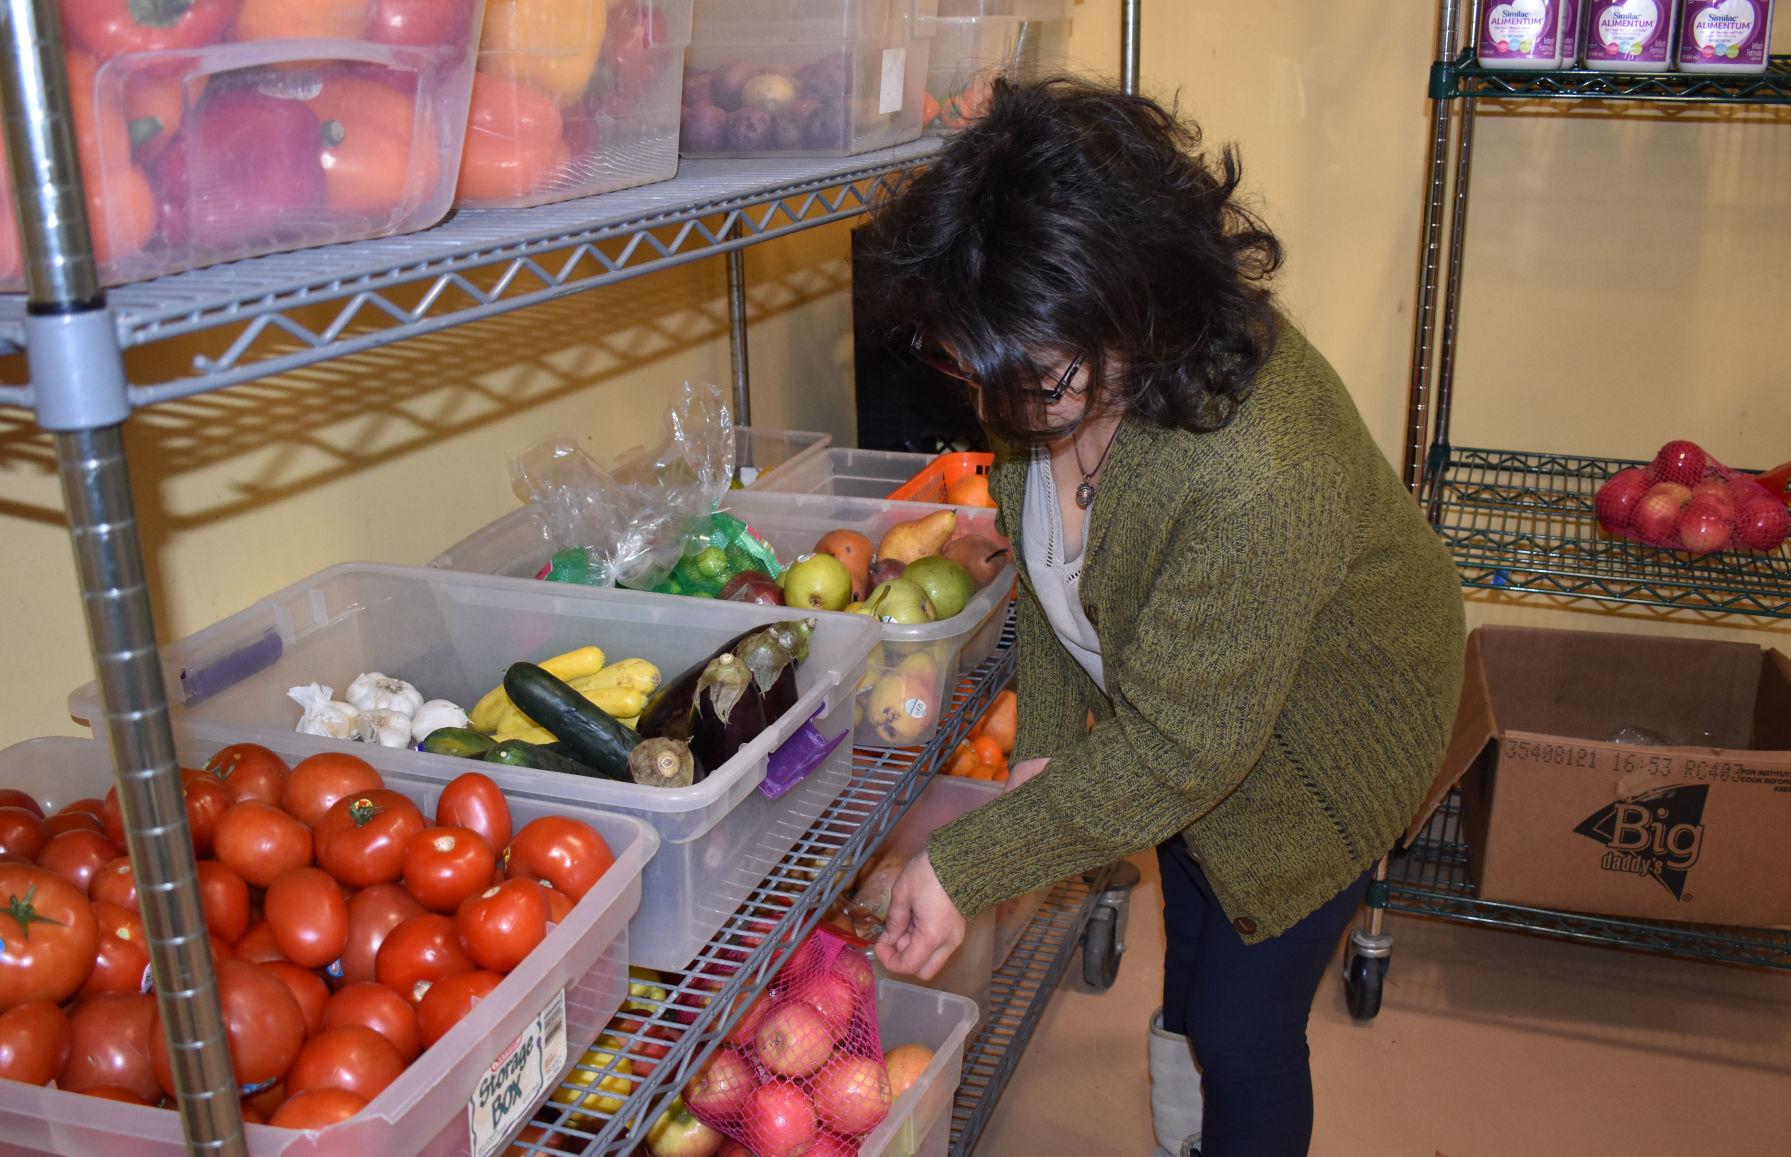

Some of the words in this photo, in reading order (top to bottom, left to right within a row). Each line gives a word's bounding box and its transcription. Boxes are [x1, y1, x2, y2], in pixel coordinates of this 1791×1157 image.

[1502, 10, 1529, 18] Similac
[1612, 12, 1640, 20] Similac
[1708, 14, 1738, 22] Similac
[1491, 17, 1542, 25] ALIMENTUM
[1601, 19, 1653, 28] ALIMENTUM
[1696, 22, 1750, 30] ALIMENTUM
[1741, 776, 1763, 784] COOK
[1607, 802, 1705, 872] Big
[1601, 850, 1664, 877] daddy's
[478, 1034, 534, 1108] Storage
